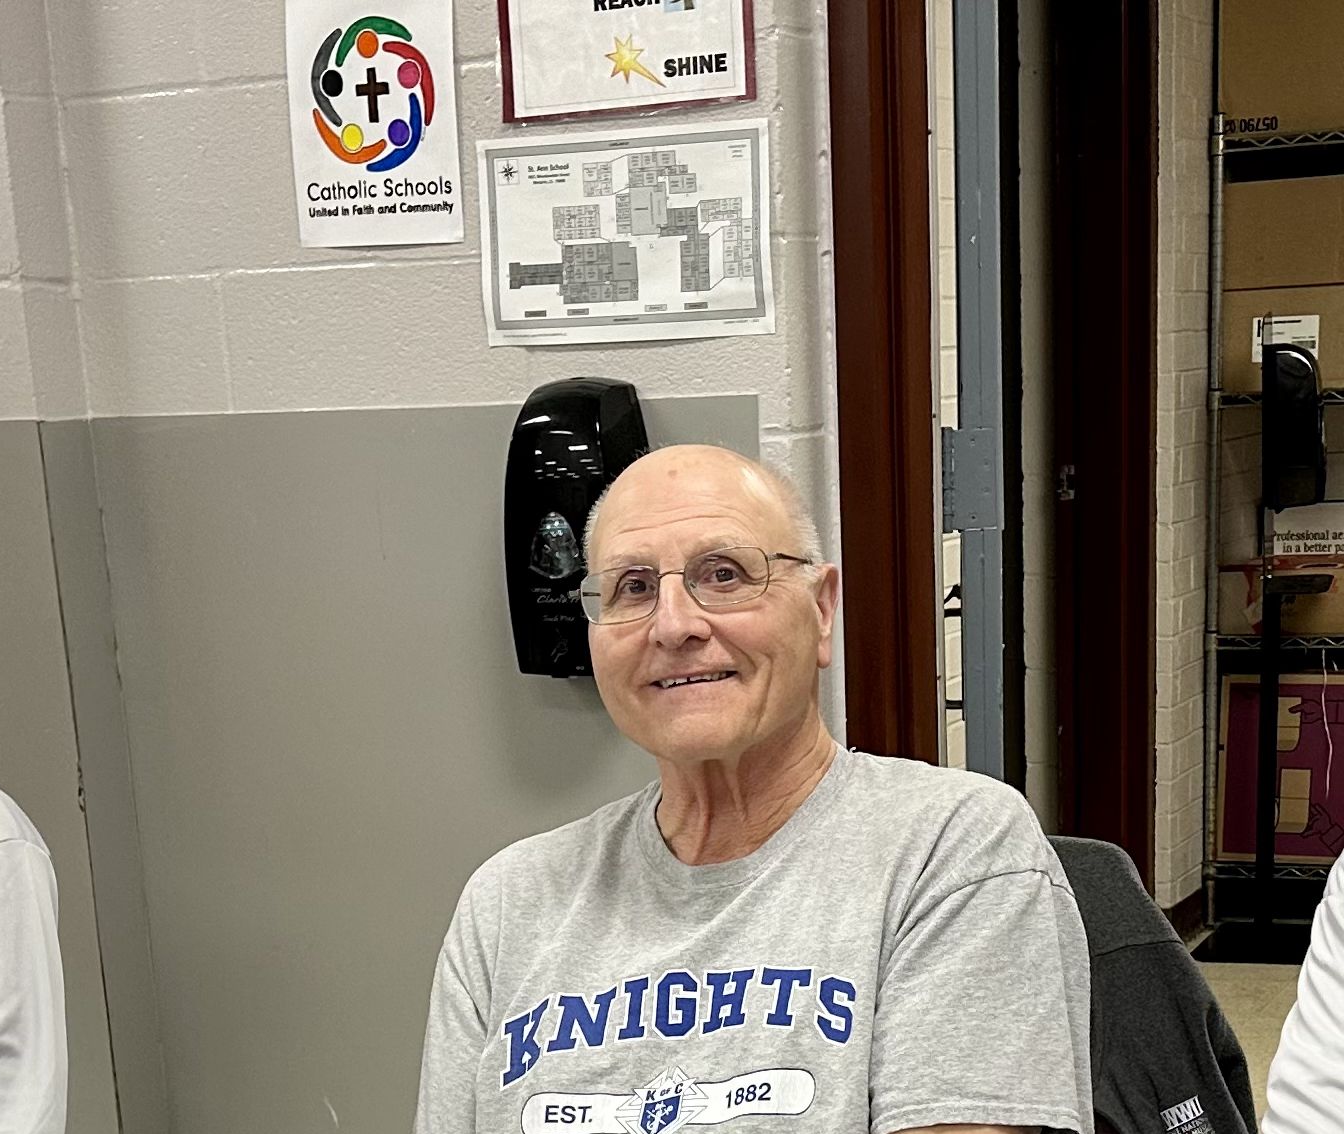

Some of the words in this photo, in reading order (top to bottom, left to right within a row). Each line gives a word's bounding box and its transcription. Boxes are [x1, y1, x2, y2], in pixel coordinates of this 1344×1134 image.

[664, 53, 727, 78] SHINE
[307, 180, 378, 201] Catholic
[384, 176, 452, 197] Schools
[309, 206, 338, 218] United
[342, 206, 349, 216] in
[352, 204, 374, 215] Faith
[378, 203, 396, 214] and
[400, 201, 453, 214] Community
[1283, 543, 1293, 553] in
[1304, 542, 1332, 553] better
[500, 967, 856, 1087] KNIGHTS
[544, 1105, 593, 1124] EST.
[725, 1082, 771, 1109] 1882
[645, 1089, 656, 1101] K
[674, 1082, 685, 1095] C
[1160, 1095, 1204, 1131] WWII
